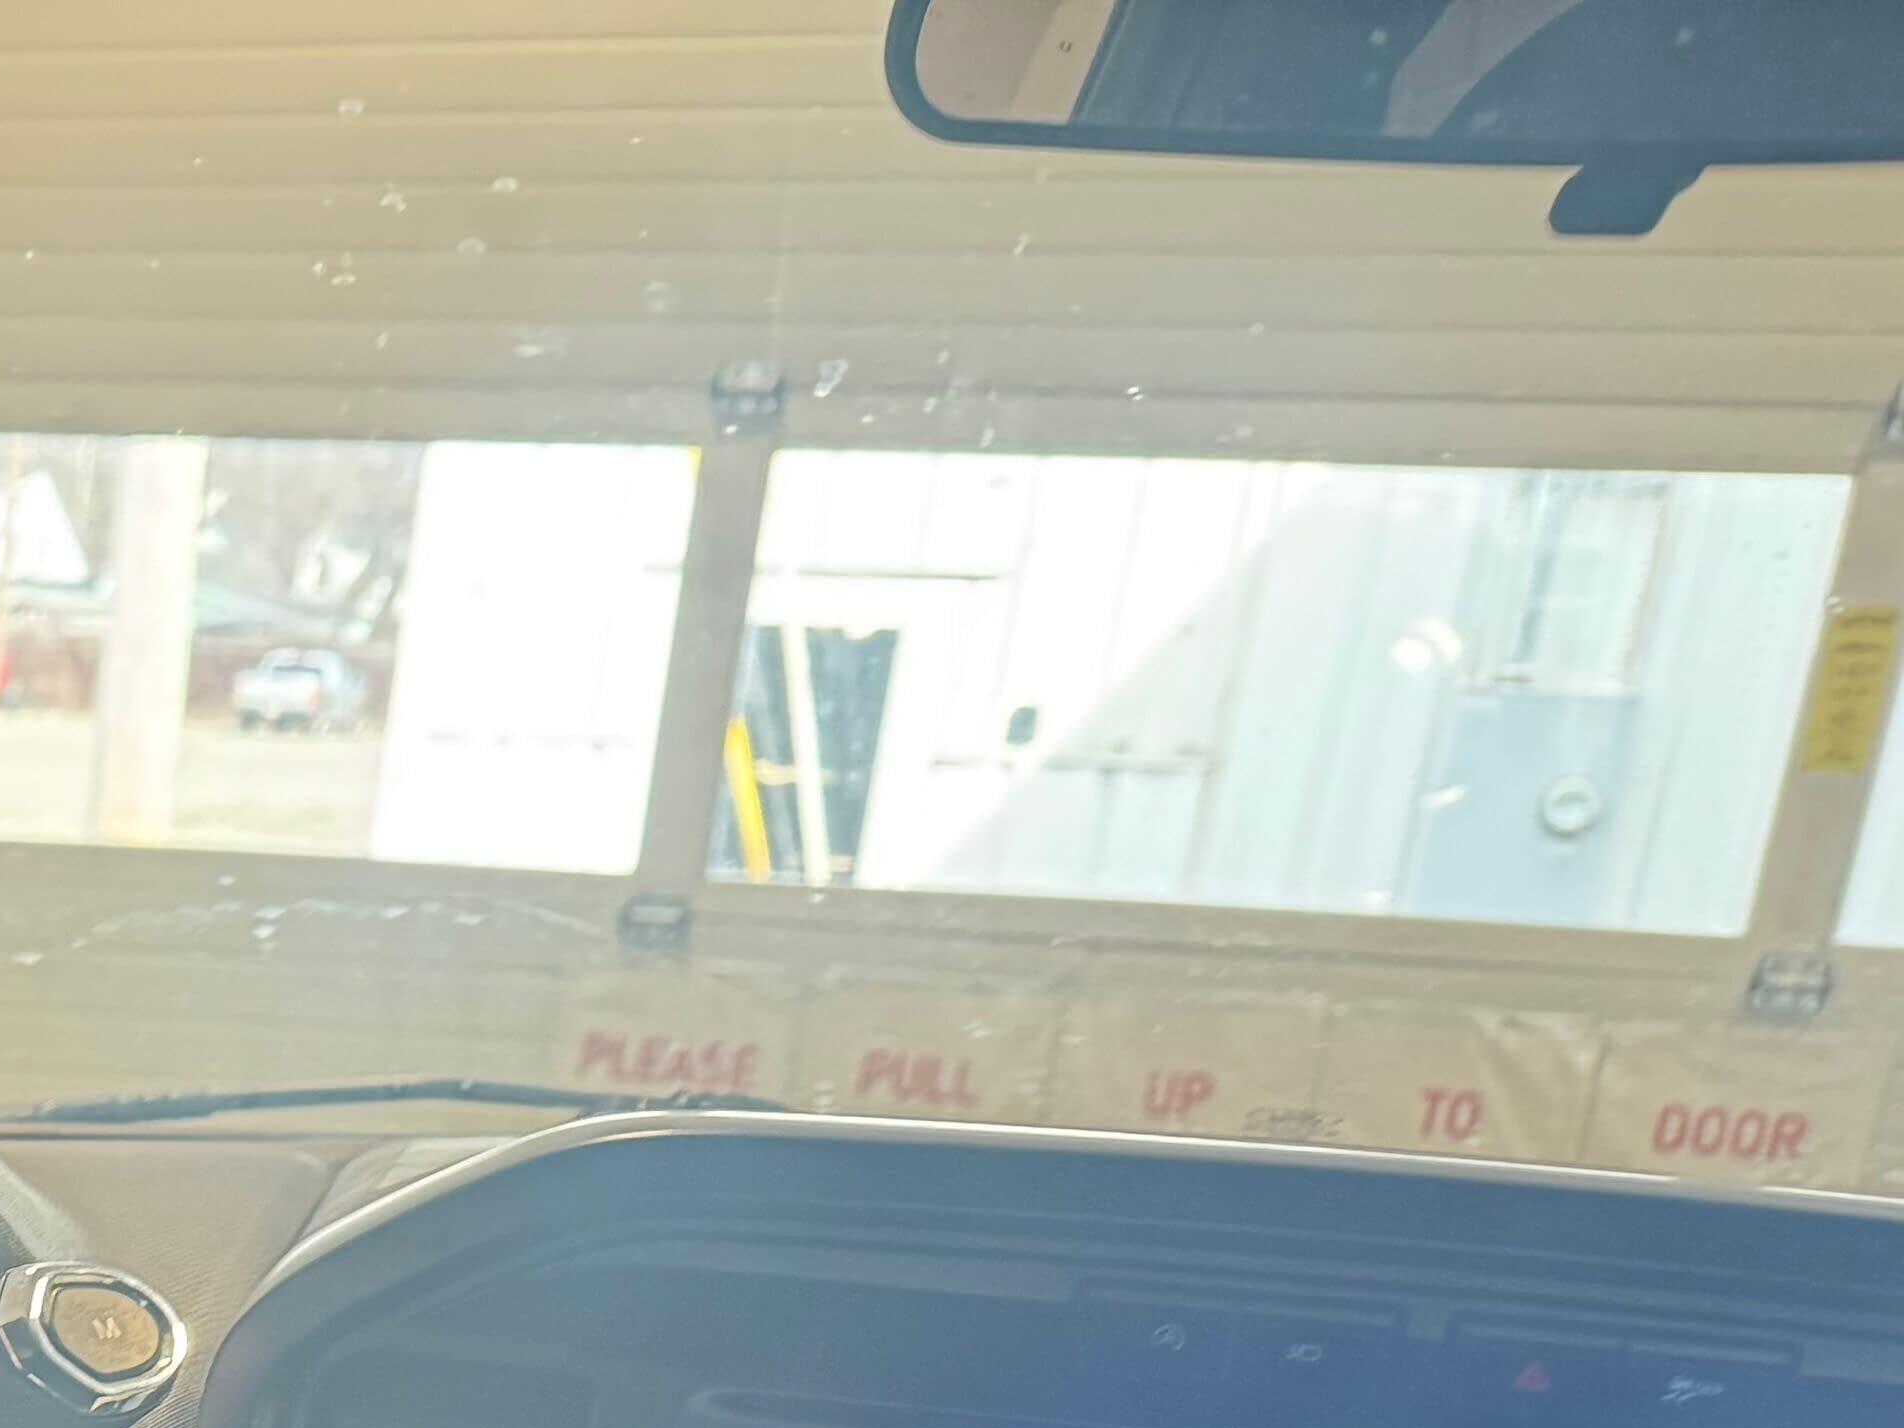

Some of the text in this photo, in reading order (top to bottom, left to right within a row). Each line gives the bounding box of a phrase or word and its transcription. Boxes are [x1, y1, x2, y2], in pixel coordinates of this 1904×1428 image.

[575, 1029, 1809, 1161] PLEASE PULL UP TO DOOR
